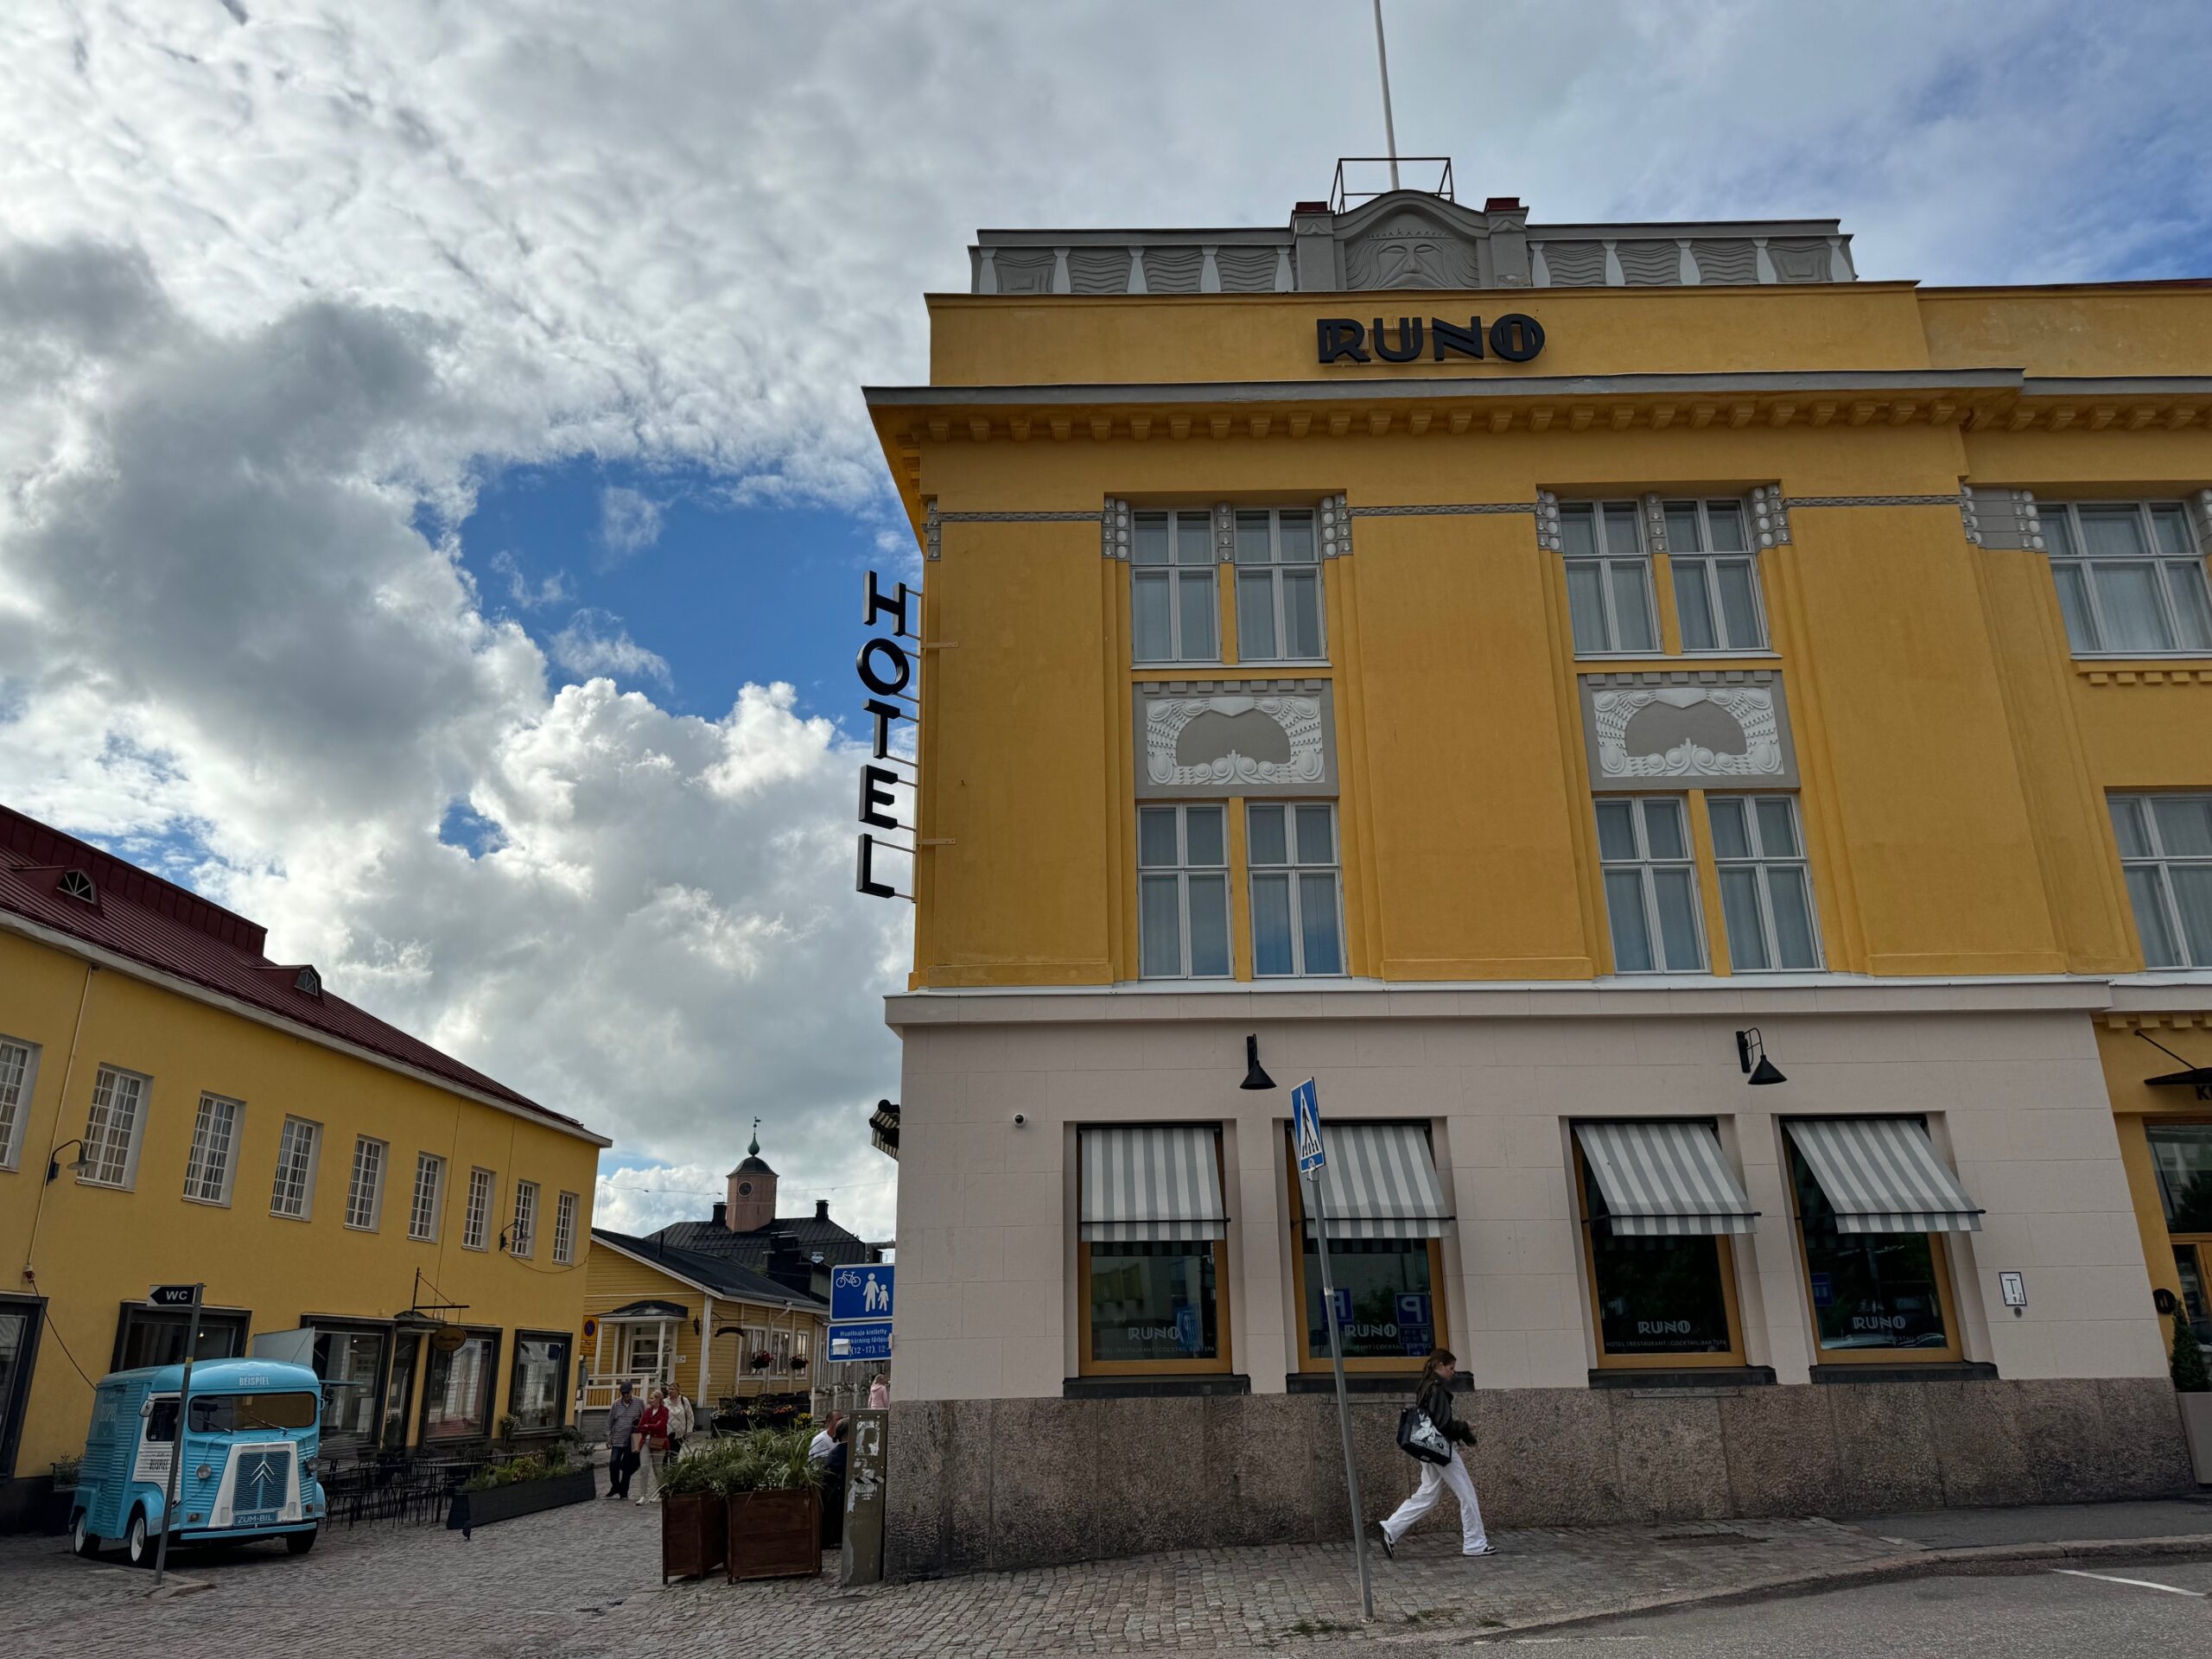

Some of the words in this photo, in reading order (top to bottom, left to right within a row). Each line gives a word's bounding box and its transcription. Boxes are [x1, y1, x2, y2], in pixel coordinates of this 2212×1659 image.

[1317, 314, 1545, 363] RUNO
[856, 570, 910, 899] HOTEL
[2196, 1085, 2212, 1101] K
[166, 1290, 188, 1300] WC
[1637, 1319, 1691, 1334] RUNO
[1853, 1315, 1906, 1330] RUNO
[1128, 1326, 1180, 1340] RUNO
[1344, 1324, 1397, 1338] RUNO
[238, 1376, 270, 1386] BEISPIEL
[238, 1514, 273, 1524] ZUM-BIL
